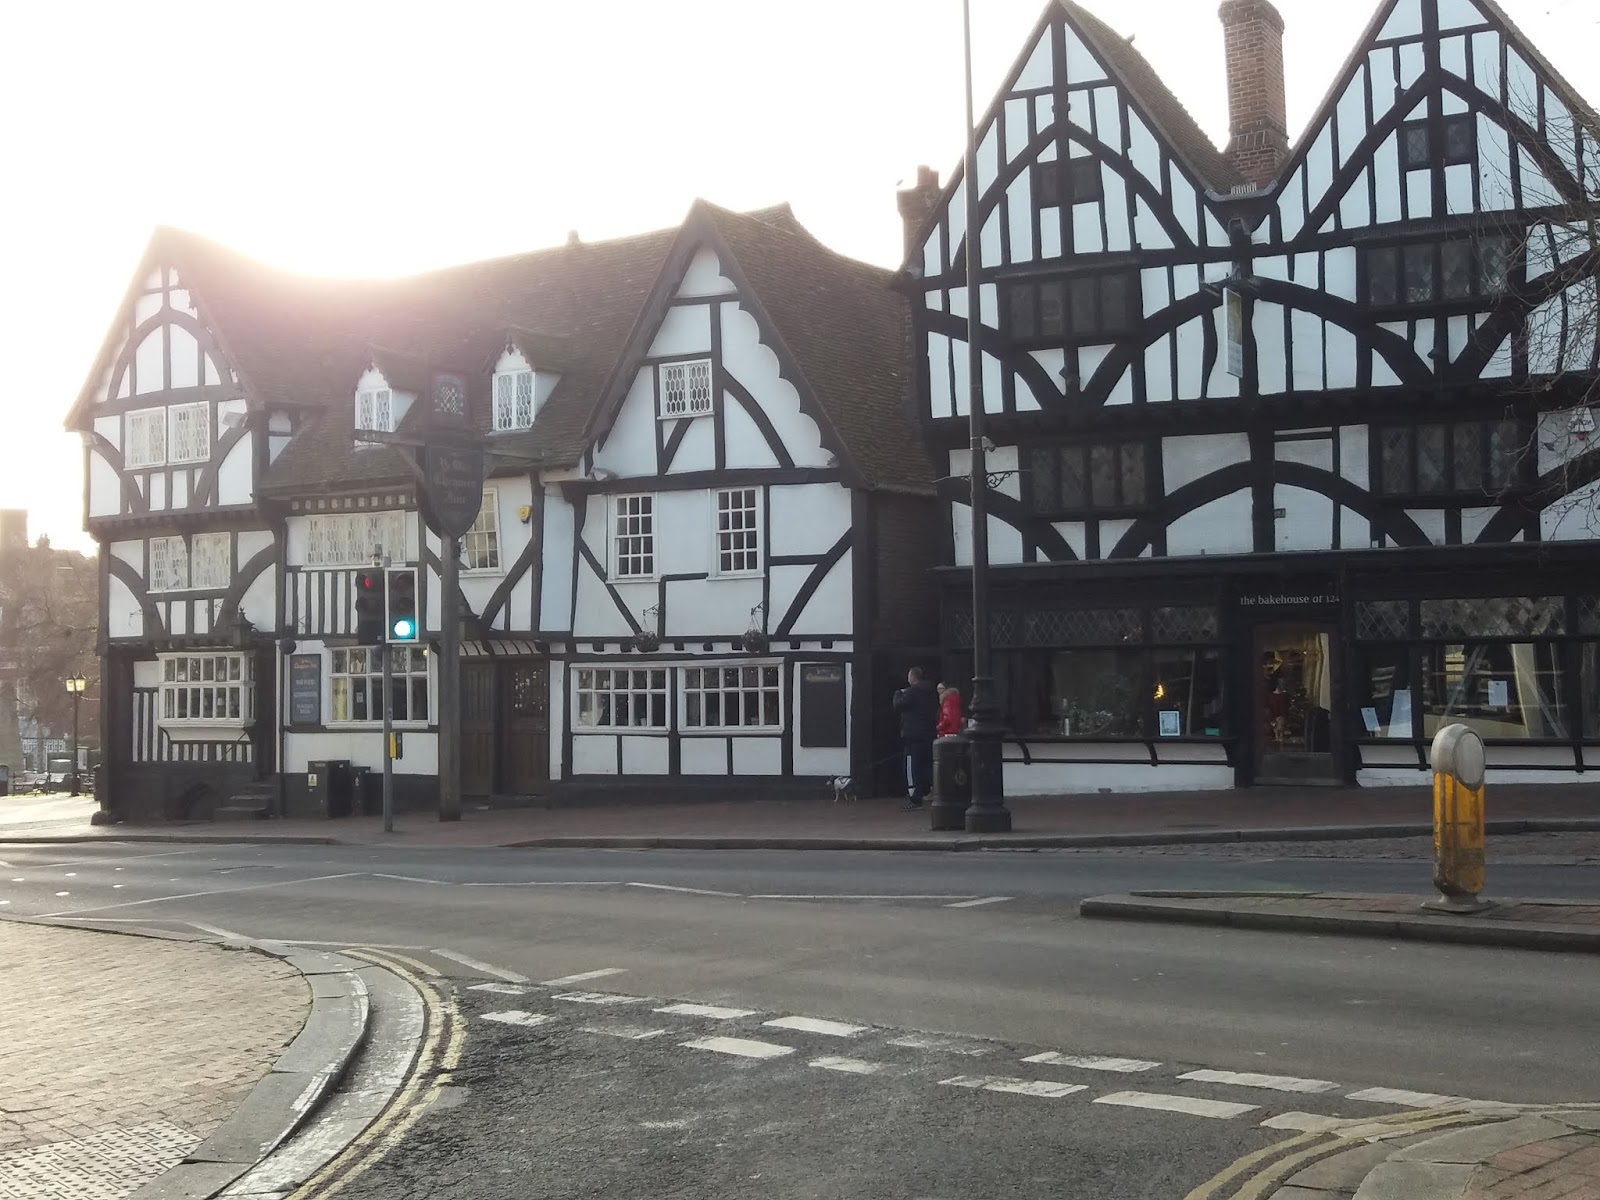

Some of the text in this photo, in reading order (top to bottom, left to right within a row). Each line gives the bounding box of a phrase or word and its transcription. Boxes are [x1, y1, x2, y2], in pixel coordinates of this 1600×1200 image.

[1240, 595, 1256, 606] the
[1257, 594, 1310, 605] bakehouse
[1312, 595, 1323, 604] at
